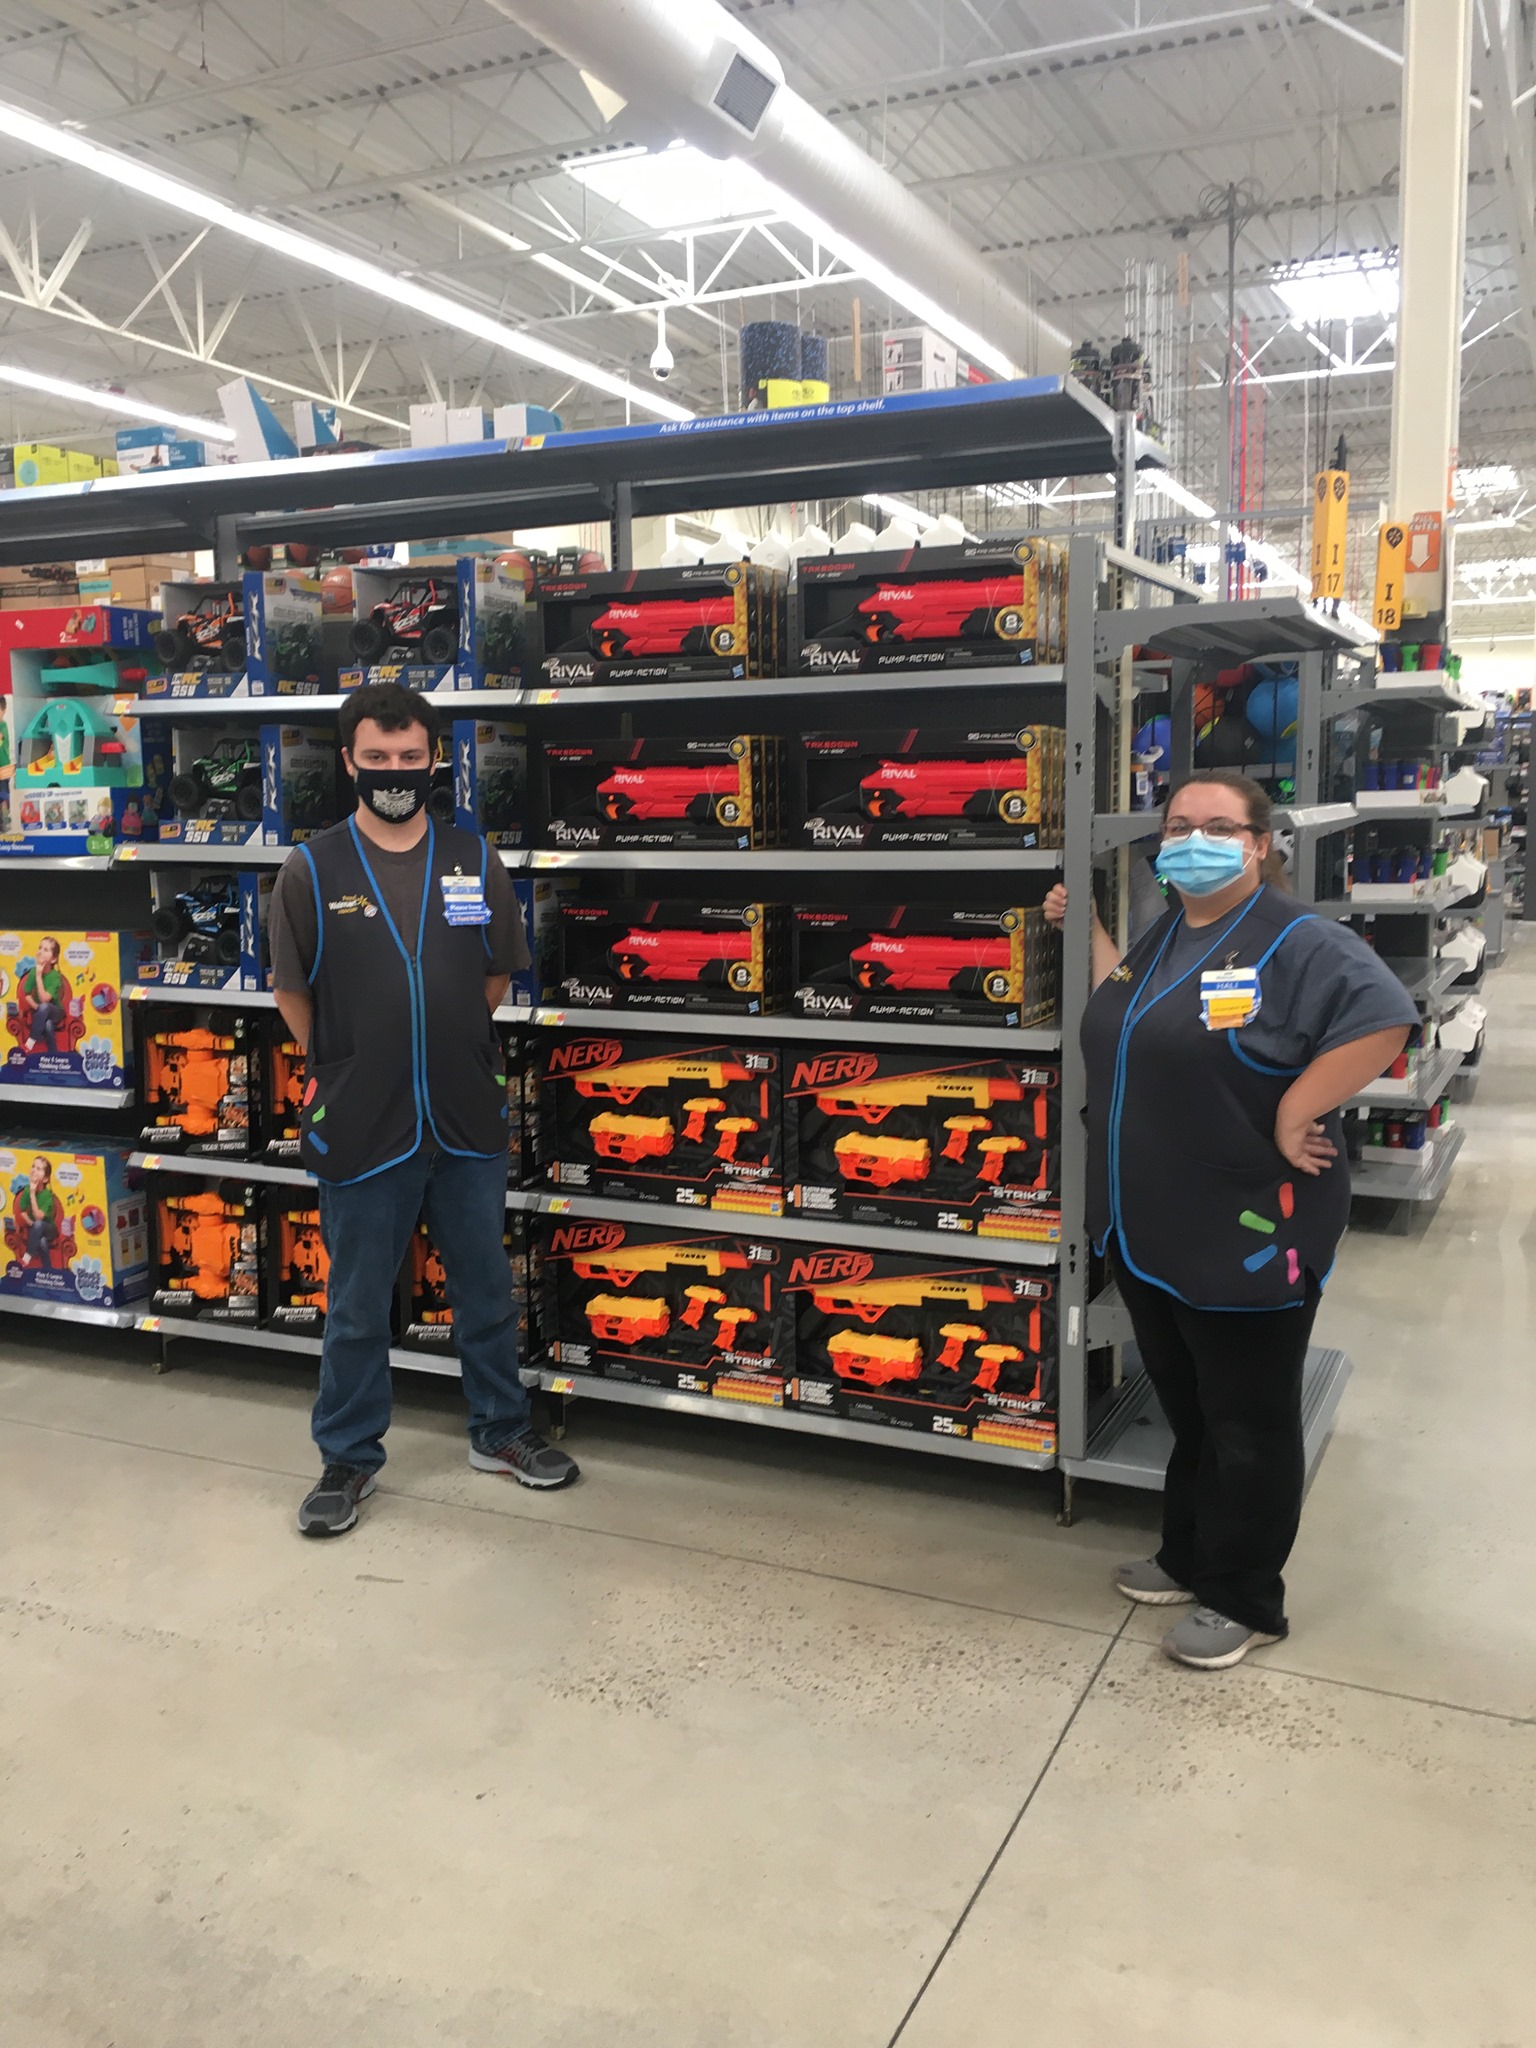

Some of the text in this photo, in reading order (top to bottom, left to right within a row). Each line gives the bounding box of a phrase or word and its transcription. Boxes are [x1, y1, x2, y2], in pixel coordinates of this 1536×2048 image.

[659, 398, 885, 433] Ask for assistance with items on the top shelf.
[1332, 544, 1338, 565] I
[1327, 573, 1341, 592] 17
[878, 590, 915, 601] RIVAL
[1385, 583, 1393, 600] I
[609, 609, 640, 618] RIVAL
[1377, 608, 1396, 625] 18
[60, 632, 66, 643] 2
[809, 649, 861, 667] RIVAL
[878, 653, 945, 664] PUMP-ACTION
[550, 664, 595, 680] RIVAL
[609, 668, 668, 678] PUMP-ACTION
[614, 774, 646, 784] RIVAL
[881, 769, 917, 779] RIVAL
[555, 826, 600, 841] RIVAL
[615, 834, 673, 843] PUMP-ACTION
[812, 826, 865, 841] RIVAL
[881, 832, 948, 842] PUMP-ACTION
[628, 936, 659, 947] RIVAL
[870, 942, 905, 953] RIVAL
[569, 986, 613, 999] RIVAL
[628, 995, 685, 1005] PUMP-ACTION
[803, 996, 853, 1010] RIVAL
[869, 1005, 934, 1016] PUMP-ACTION
[549, 1037, 623, 1071] NERF
[745, 1054, 758, 1069] 31
[791, 1052, 878, 1089] NERF
[1020, 1068, 1036, 1084] 31
[551, 1221, 626, 1252] NERF
[748, 1246, 761, 1261] 31
[788, 1250, 874, 1285] NERF
[1014, 1280, 1029, 1295] 31
